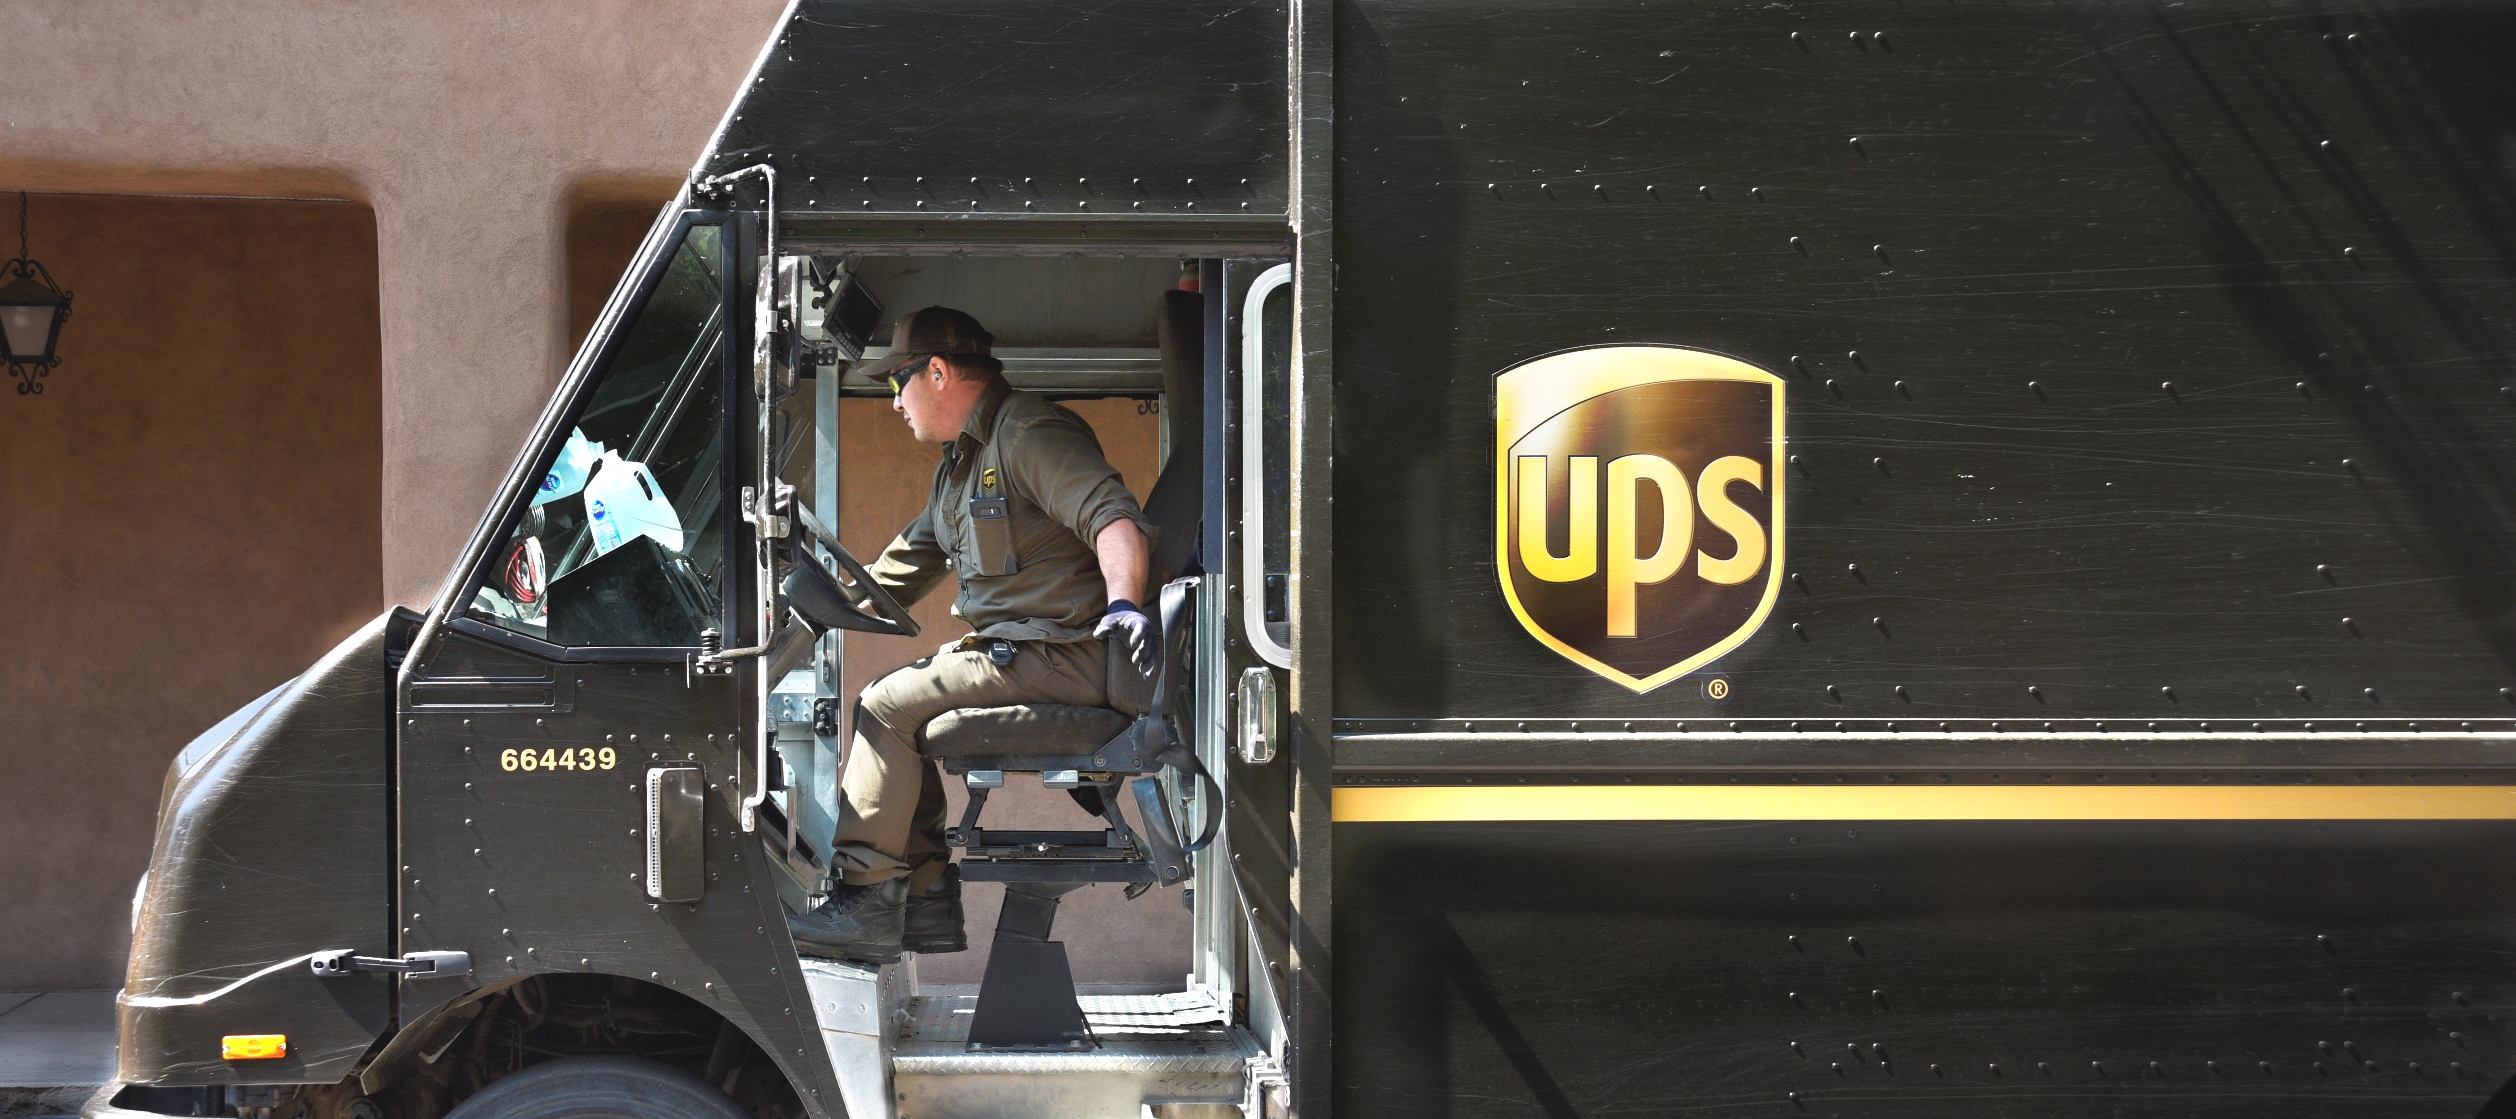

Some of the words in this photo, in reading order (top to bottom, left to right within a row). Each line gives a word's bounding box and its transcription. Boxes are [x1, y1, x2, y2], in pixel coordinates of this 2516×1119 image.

[983, 475, 996, 488] ups
[1517, 453, 1767, 639] ups
[501, 747, 616, 771] 664439
